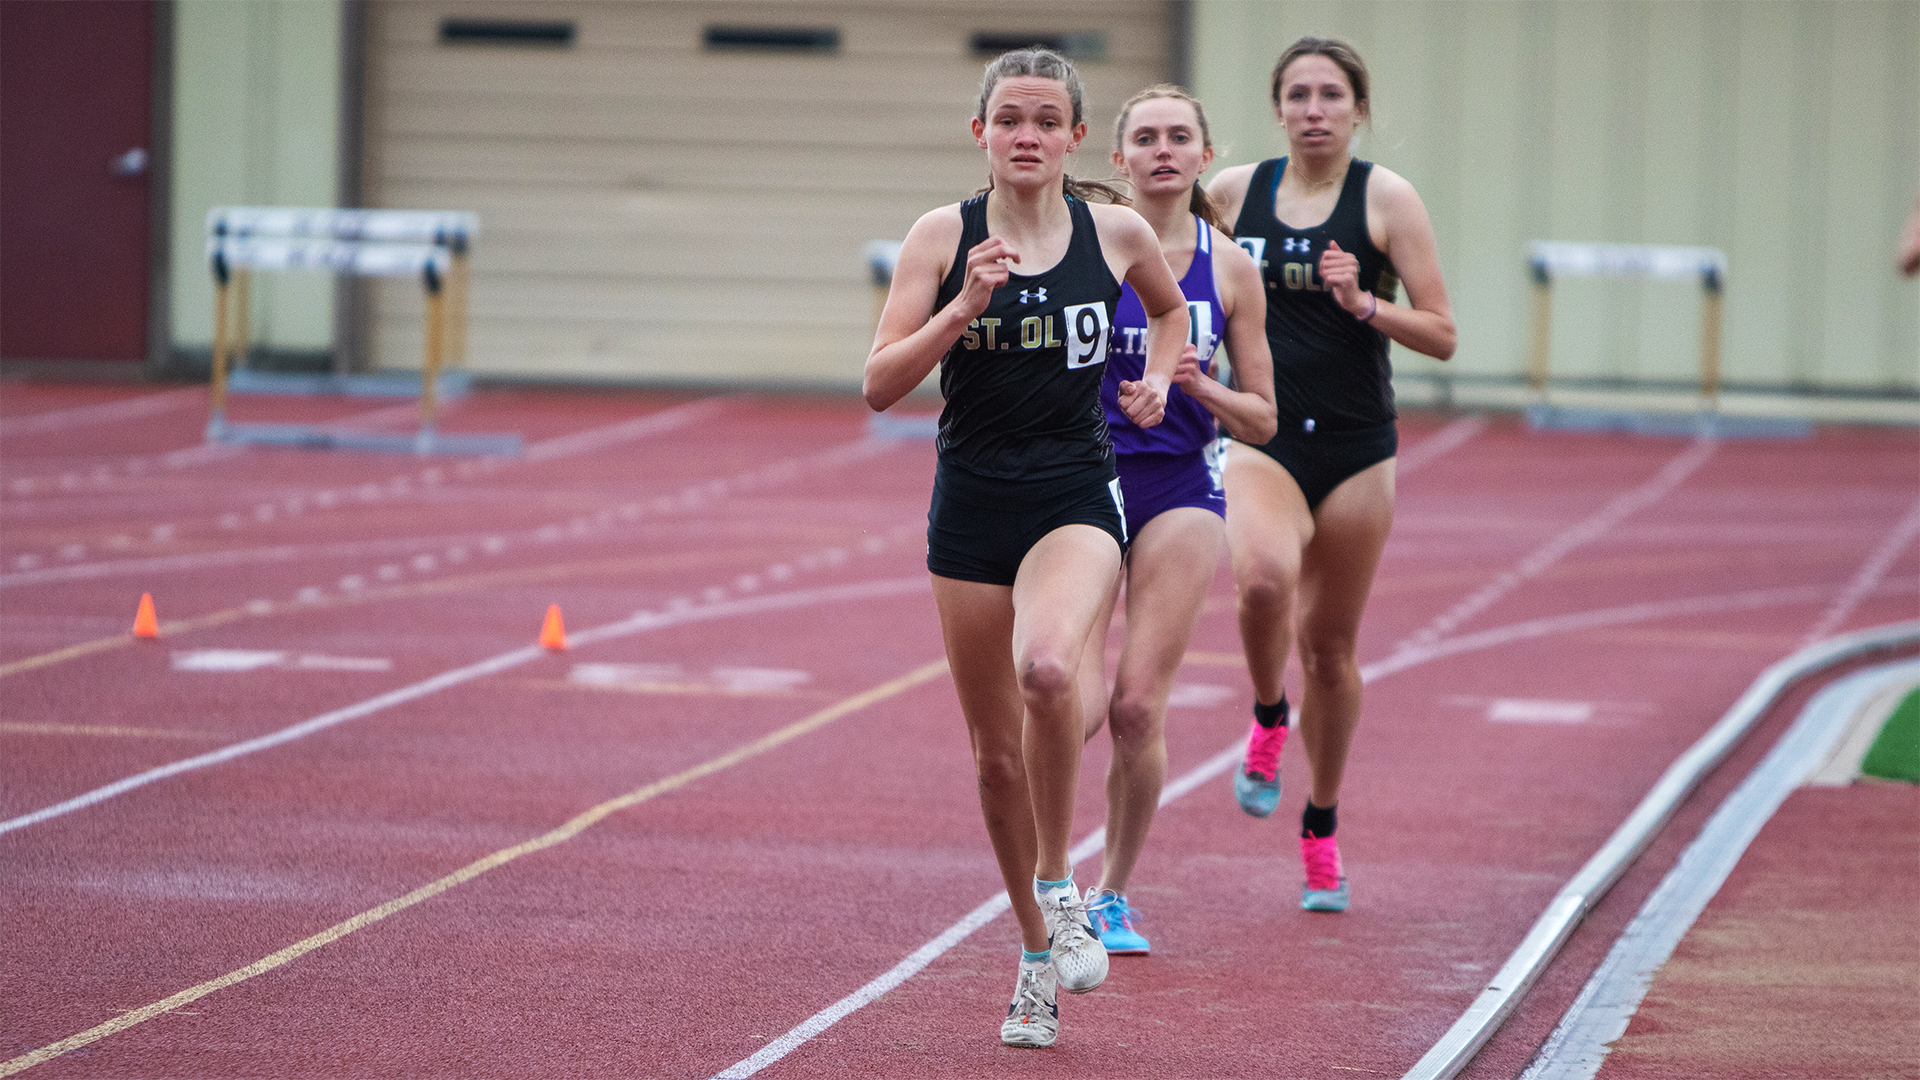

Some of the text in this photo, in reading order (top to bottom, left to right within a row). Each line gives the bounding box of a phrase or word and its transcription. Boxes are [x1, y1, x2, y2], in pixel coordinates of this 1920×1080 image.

[963, 317, 1009, 350] ST.
[1021, 315, 1069, 349] OL
[1075, 307, 1101, 364] 9
